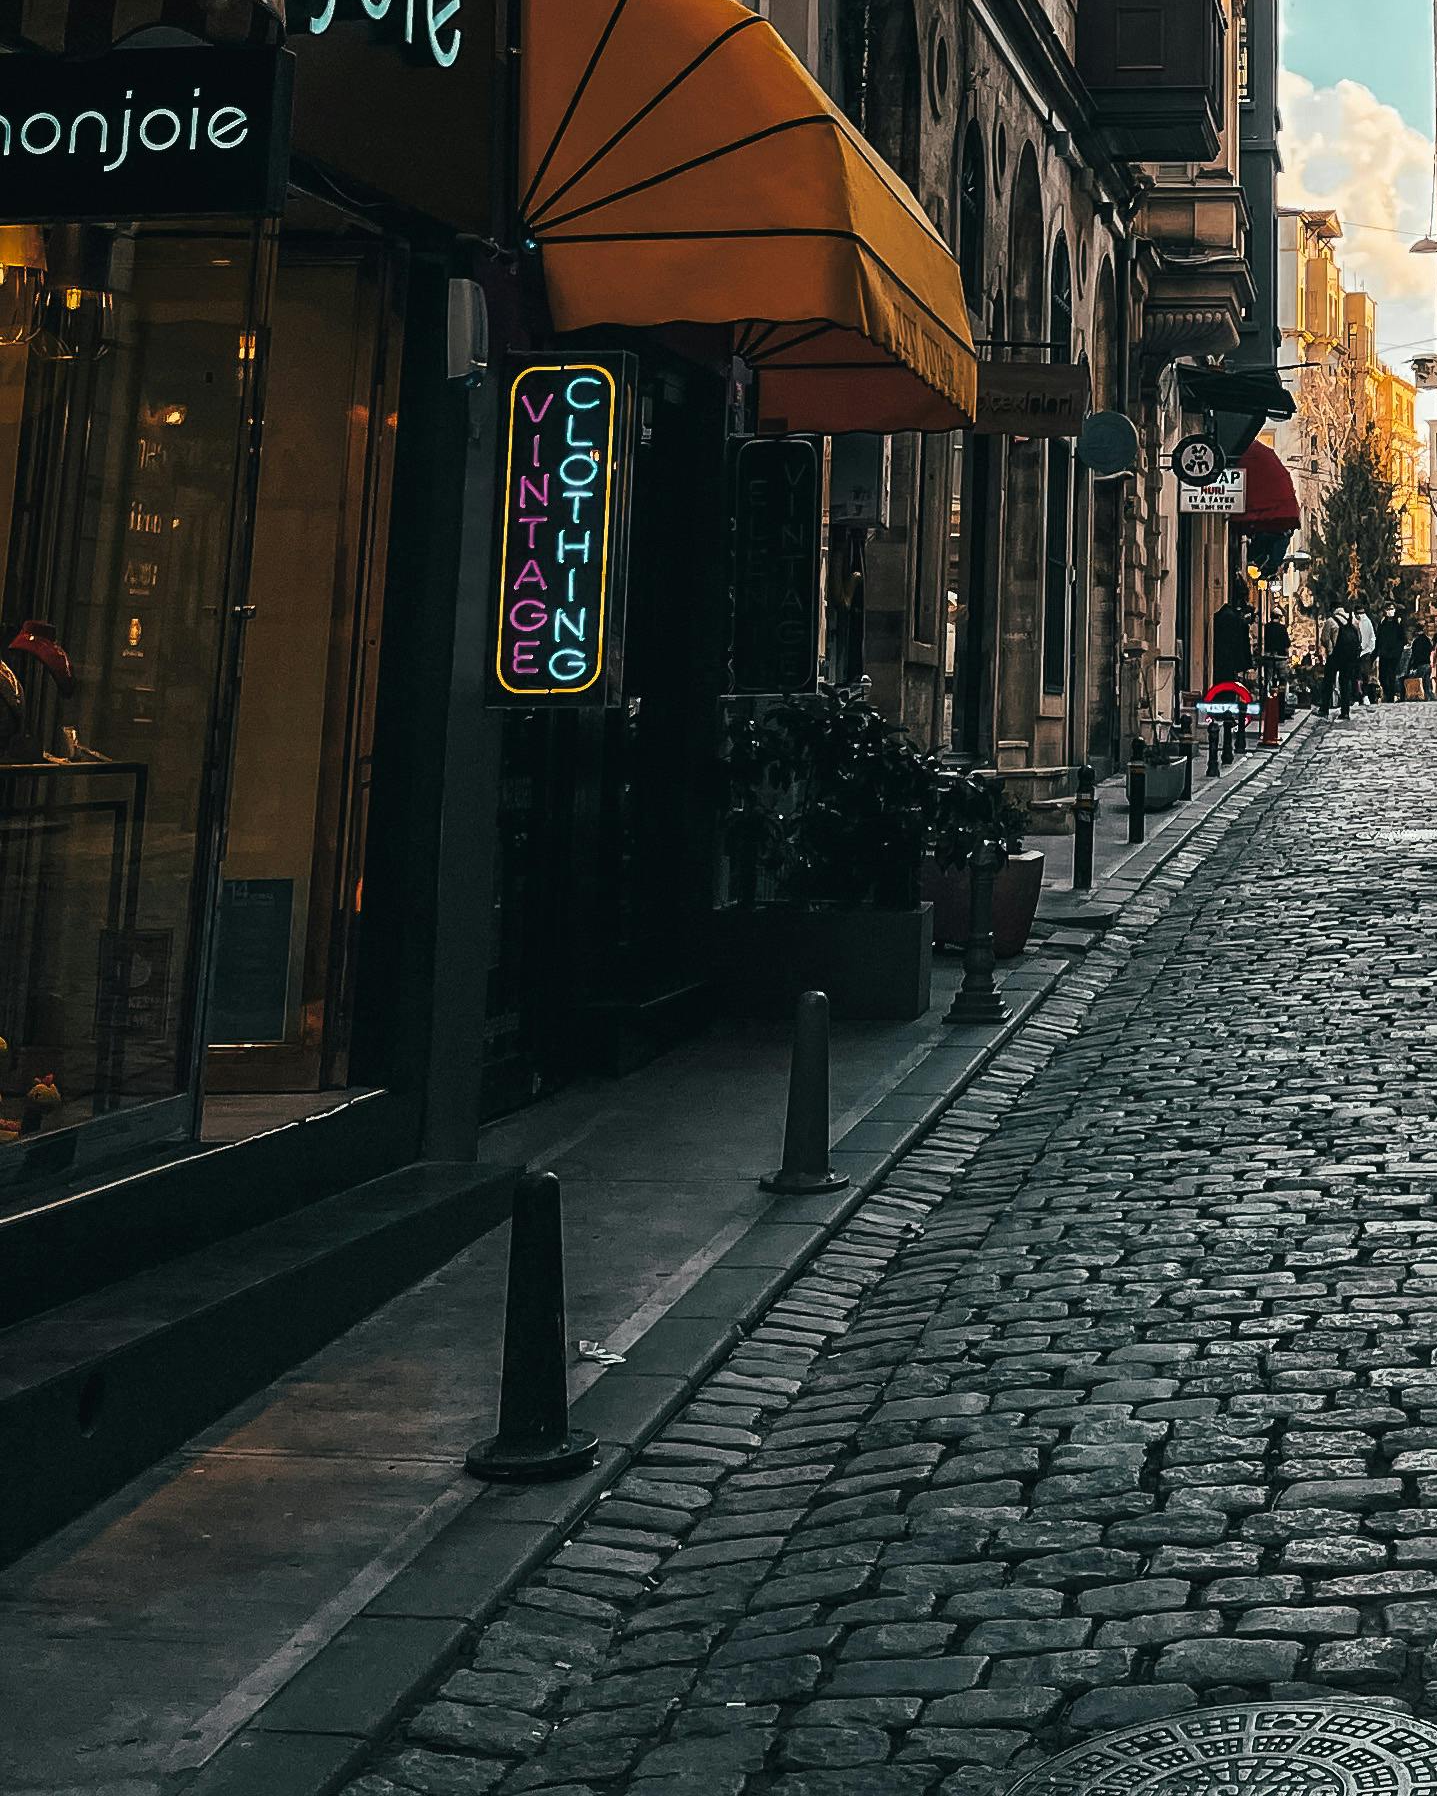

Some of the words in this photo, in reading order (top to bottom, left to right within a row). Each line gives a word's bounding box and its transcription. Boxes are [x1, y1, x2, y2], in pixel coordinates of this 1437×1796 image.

[0, 88, 248, 172] onjoie
[510, 393, 554, 674] VINTAGE
[548, 377, 602, 681] CLOTHING
